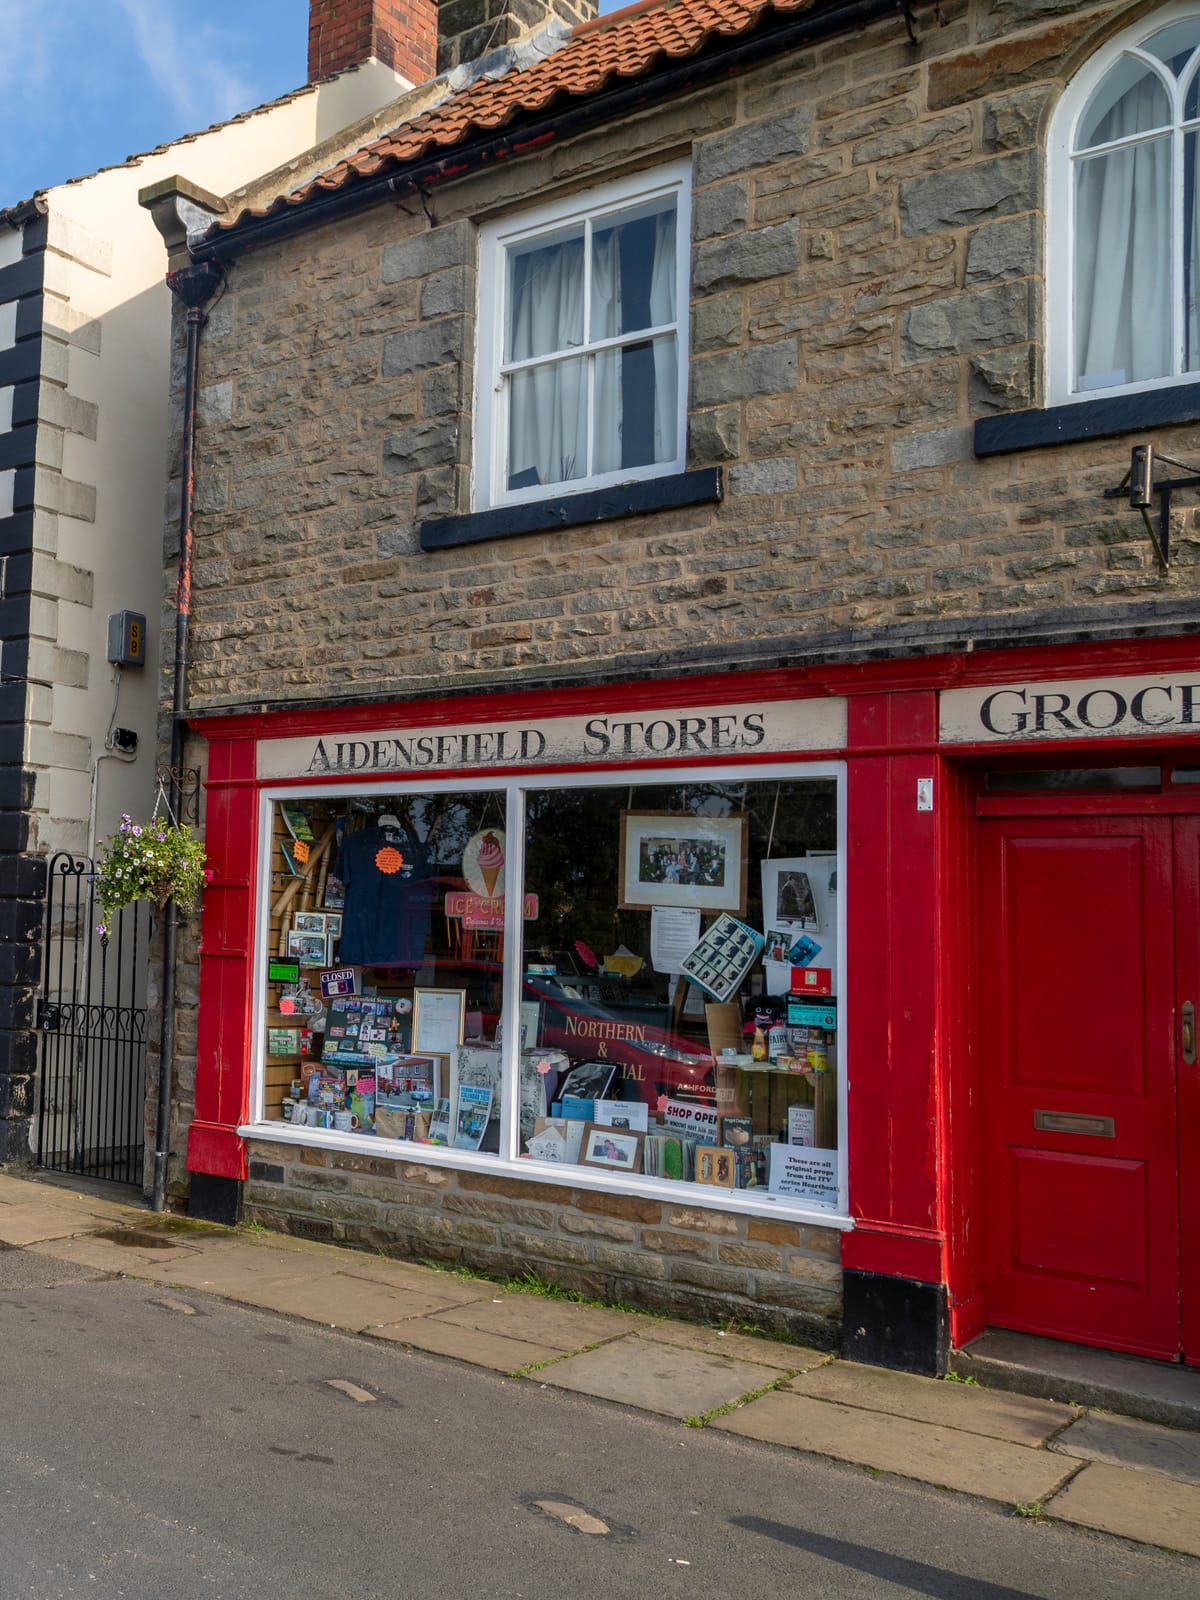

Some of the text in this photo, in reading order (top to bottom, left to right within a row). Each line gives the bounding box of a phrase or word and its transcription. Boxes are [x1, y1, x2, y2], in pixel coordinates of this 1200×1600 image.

[131, 624, 138, 638] S
[304, 712, 765, 772] AIDENSFIELD STORES
[321, 970, 353, 983] CLOSED
[564, 1015, 647, 1042] NORTHERN
[597, 1041, 608, 1058] &
[677, 1083, 717, 1093] AHFORD
[666, 1106, 693, 1119] SHOP
[669, 1120, 687, 1129] WINDOWS
[788, 1156, 808, 1164] These
[784, 1164, 834, 1176] original props
